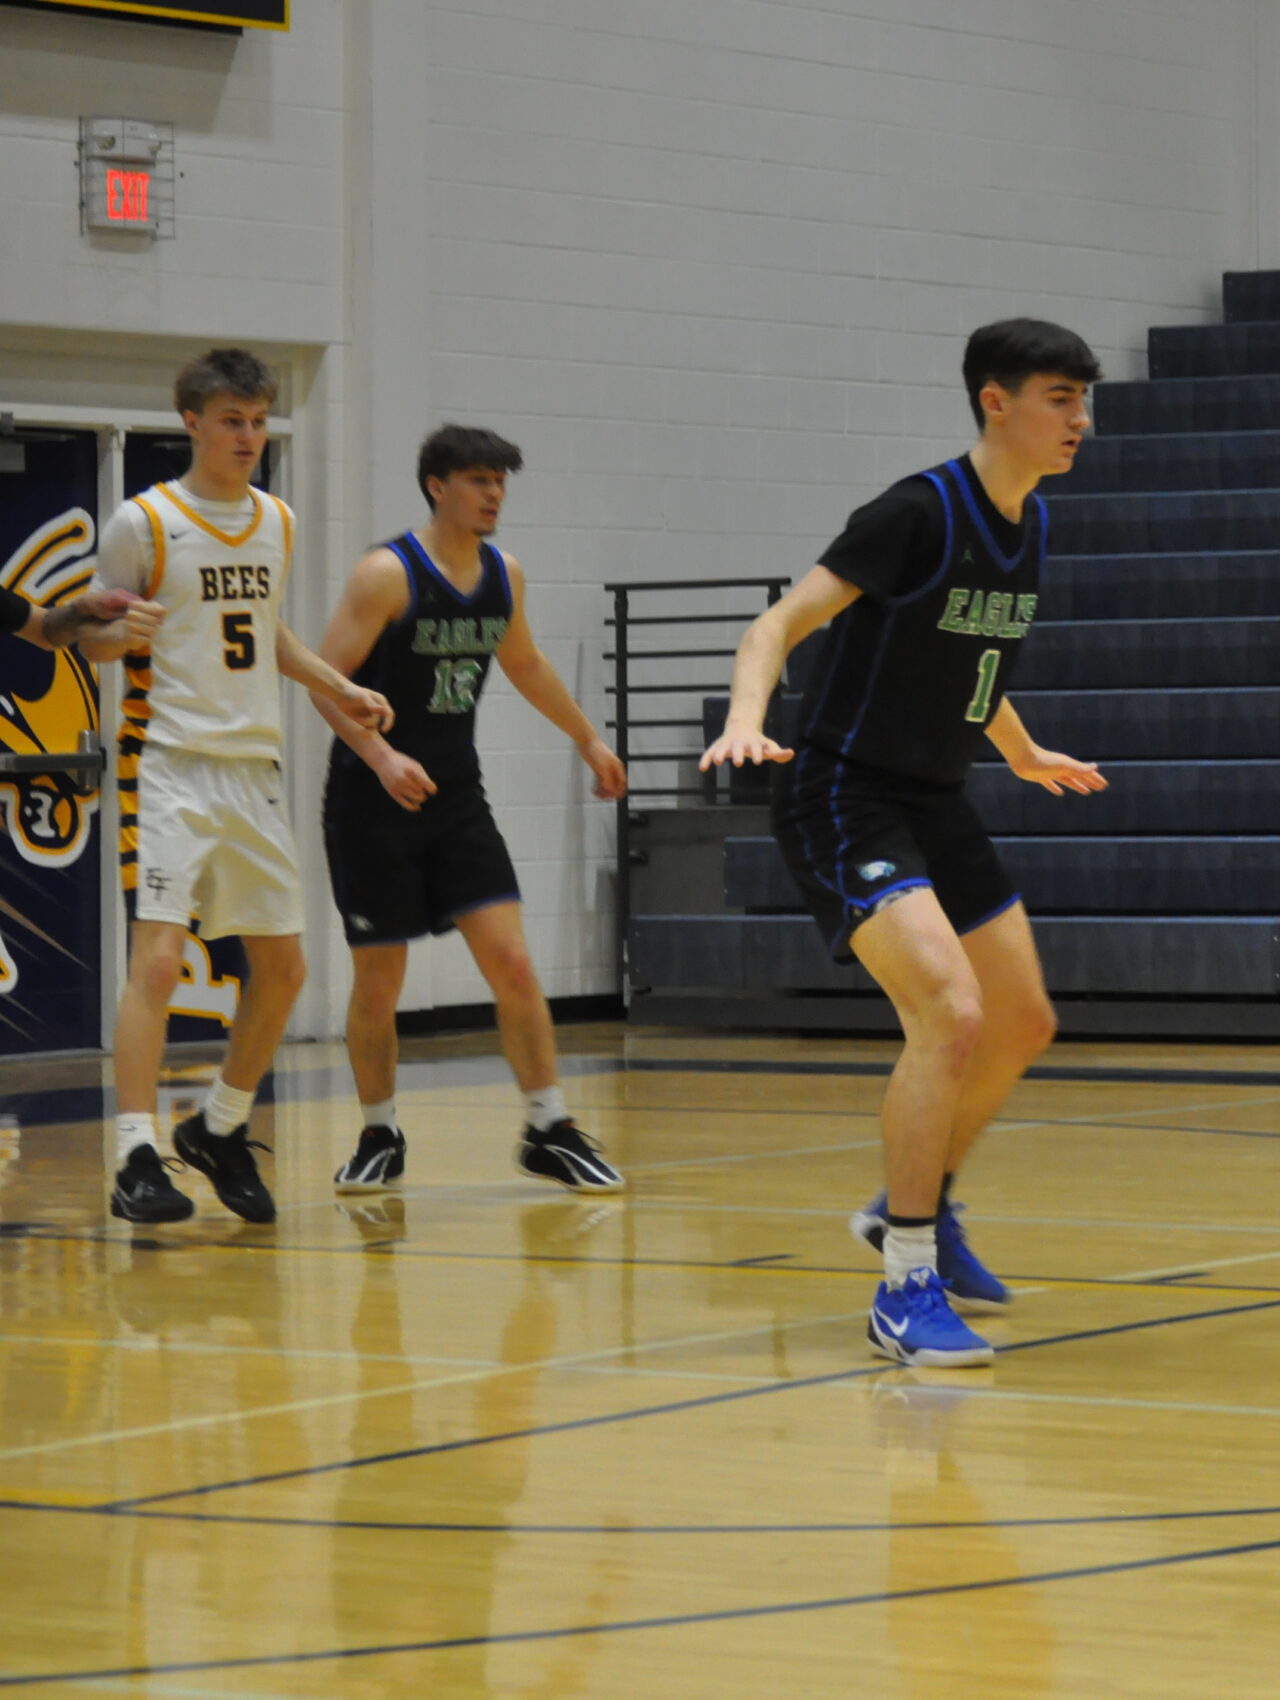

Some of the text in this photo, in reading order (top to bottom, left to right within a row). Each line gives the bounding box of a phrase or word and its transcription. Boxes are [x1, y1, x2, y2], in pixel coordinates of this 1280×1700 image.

[106, 168, 151, 222] EXIT
[199, 566, 270, 601] BEES
[221, 611, 256, 671] 5
[964, 649, 1001, 722] 1
